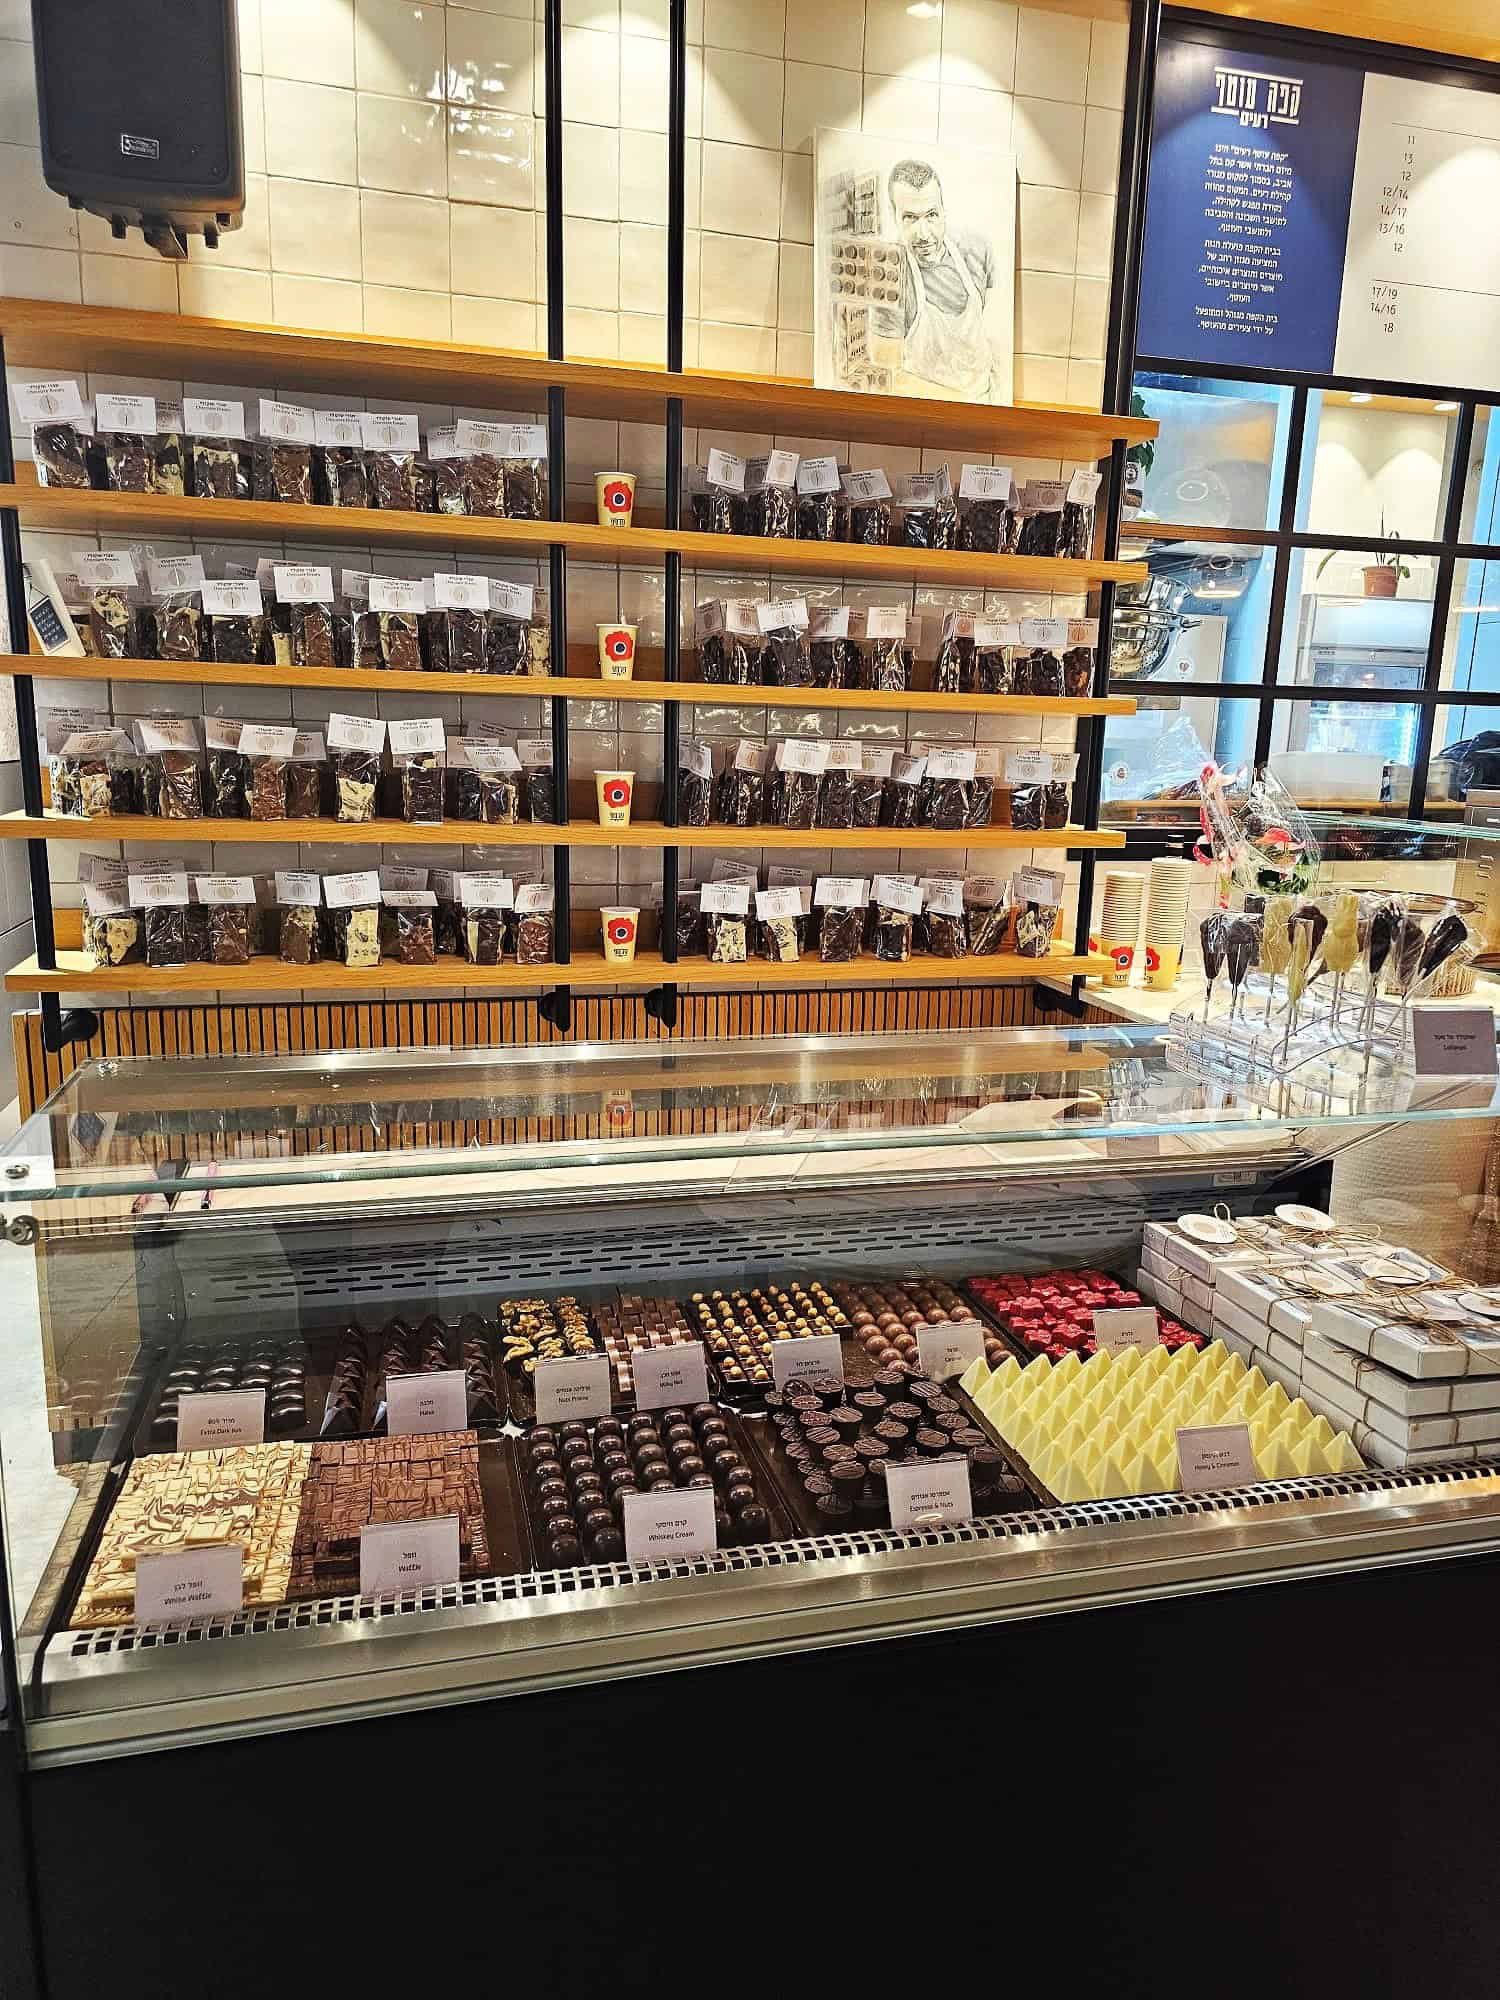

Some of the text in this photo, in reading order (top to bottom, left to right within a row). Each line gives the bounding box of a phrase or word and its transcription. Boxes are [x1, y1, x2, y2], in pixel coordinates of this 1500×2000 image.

[1216, 74, 1301, 117] קפה עוטף
[1239, 110, 1268, 129] רעים
[1408, 136, 1415, 145] 11
[1404, 152, 1413, 164] 13
[1209, 155, 1292, 175] מיזם חברתי אשר קם בתל
[1227, 172, 1248, 182] למקום
[1250, 175, 1271, 185] בסמוך
[1401, 171, 1412, 181] 12
[1227, 186, 1248, 195] המקום
[1383, 185, 1408, 200] 12/14
[1242, 200, 1260, 210] מפגש
[1380, 204, 1407, 218] 14/17
[1235, 211, 1260, 222] השכונה
[1378, 223, 1405, 235] 13/16
[1223, 241, 1243, 251] פועלת
[1245, 245, 1263, 255] הקפה
[1394, 242, 1403, 253] 12
[1207, 251, 1217, 261] של
[1265, 247, 1280, 256] בבית
[1219, 254, 1232, 262] רחב
[1252, 259, 1277, 268] המציעה
[1260, 284, 1274, 293] אשר
[1372, 286, 1398, 299] 17/19
[1370, 302, 1397, 315] 14/16
[1246, 313, 1264, 322] הקפה
[1265, 315, 1278, 323] בית
[1228, 322, 1251, 333] צעירים
[1253, 325, 1263, 333] ידי
[1265, 326, 1274, 335] על
[1384, 322, 1394, 333] 18
